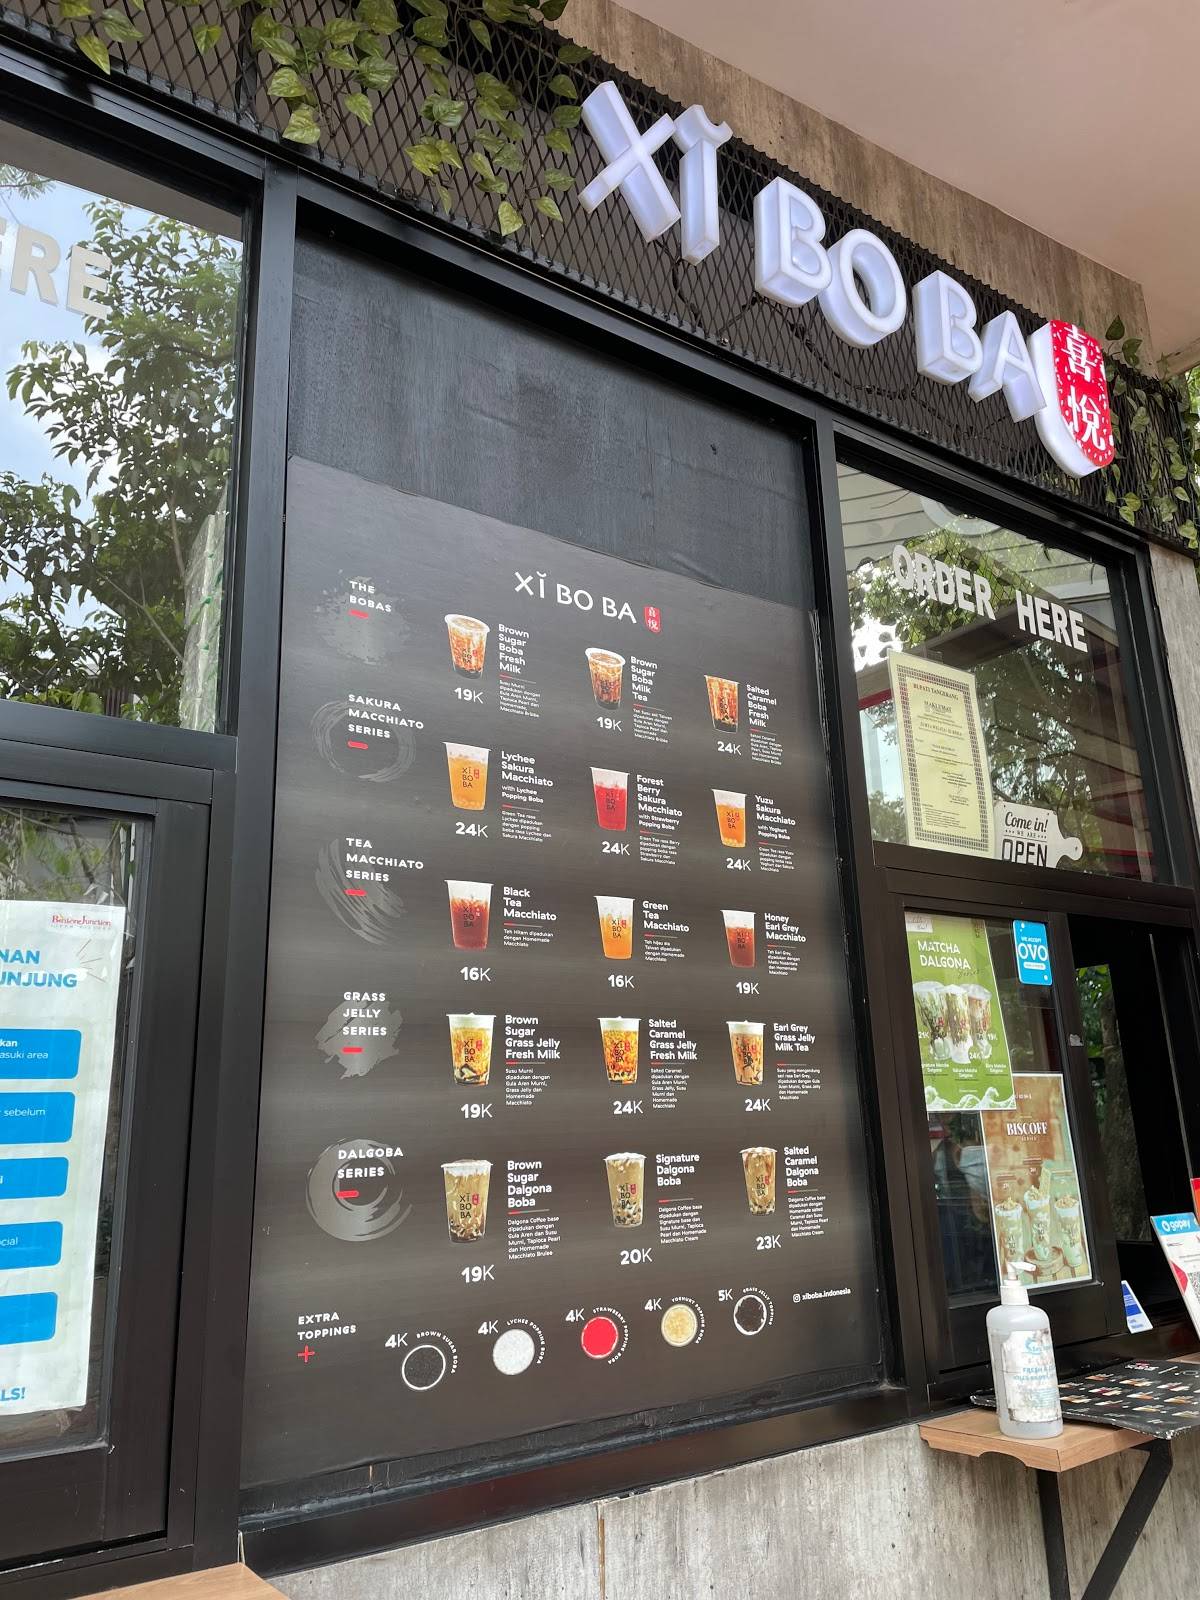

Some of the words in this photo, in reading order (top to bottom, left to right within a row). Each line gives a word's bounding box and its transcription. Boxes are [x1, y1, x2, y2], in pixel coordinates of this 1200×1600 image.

[754, 176, 906, 348] BO
[912, 270, 1047, 423] BA
[350, 581, 375, 594] THE
[350, 595, 392, 612] BOBAS
[557, 584, 593, 610] BO
[602, 597, 637, 623] BA
[892, 545, 996, 620] ORDER
[1016, 589, 1088, 653] HERE
[498, 624, 529, 638] Brown
[499, 634, 526, 647] Sugar
[499, 643, 523, 655] Boba
[500, 653, 525, 666] Fresh
[631, 656, 657, 669] Brown
[500, 662, 521, 673] Milk
[631, 666, 655, 677] Sugar
[632, 674, 653, 685] Boba
[632, 683, 651, 693] Milk
[747, 685, 769, 696] Salted
[455, 688, 484, 704] 19K
[632, 692, 648, 702] Tea
[747, 693, 776, 705] Caramel
[349, 694, 401, 711] SAKURA
[748, 701, 767, 711] Boba
[349, 708, 424, 729] MACCHIATO
[749, 710, 769, 720] Fresh
[597, 717, 622, 731] 19K
[749, 718, 766, 727] Milk
[348, 723, 390, 739] SERIES
[717, 741, 741, 755] 24K
[502, 751, 535, 764] Lychee
[502, 762, 534, 774] Sakura
[502, 771, 553, 786] Macchiato
[637, 775, 664, 786] Forest
[637, 784, 660, 796] Berry
[502, 792, 526, 802] Popping
[638, 794, 666, 804] Sakura
[755, 795, 773, 804] Yuzu
[638, 803, 682, 816] Macchiato
[756, 804, 781, 814] Sakura
[651, 816, 679, 825] Strawberry
[757, 813, 796, 825] Macchiato
[1005, 812, 1032, 829] Come
[1034, 818, 1048, 832] in!
[456, 822, 488, 838] 24K
[346, 838, 372, 848] TEA
[602, 841, 630, 855] 24K
[1002, 839, 1047, 867] OPEN
[346, 853, 424, 869] MACCHIATO
[727, 858, 751, 871] 24K
[346, 870, 389, 882] SERIES
[504, 887, 530, 897] Black
[503, 898, 521, 907] Tea
[643, 901, 668, 910] Green
[504, 908, 556, 921] Macchiato
[643, 910, 659, 919] Tea
[764, 913, 789, 923] Honey
[644, 920, 689, 932] Macchiato
[782, 924, 799, 933] Grey
[766, 931, 806, 942] Macchiato
[918, 940, 960, 954] MATCHA
[1018, 943, 1048, 961] OVO
[920, 955, 971, 969] DALGONA
[460, 967, 491, 981] 16K
[608, 975, 634, 988] 16K
[736, 982, 759, 994] 19K
[344, 992, 385, 1001] GRASS
[343, 1008, 381, 1018] JELLY
[505, 1015, 538, 1024] Brown
[649, 1019, 676, 1028] Salted
[343, 1027, 386, 1036] SERIES
[505, 1026, 535, 1037] Sugar
[774, 1023, 788, 1031] Earl
[791, 1024, 808, 1033] Grey
[649, 1030, 685, 1039] Caramel
[798, 1034, 815, 1044] Jelly
[505, 1038, 533, 1047] Grass
[537, 1038, 560, 1049] Jelly
[650, 1040, 674, 1049] Grass
[677, 1041, 696, 1051] Jelly
[775, 1043, 793, 1051] Milk
[795, 1043, 809, 1051] Tea
[506, 1049, 534, 1058] Fresh
[538, 1050, 560, 1059] Milk
[650, 1051, 675, 1060] Fresh
[678, 1051, 697, 1060] Milk
[461, 1104, 492, 1118] 19K
[613, 1100, 643, 1114] 24K
[745, 1099, 771, 1111] 24K
[4, 1108, 45, 1117] sebelum
[1007, 1122, 1048, 1136] BISCOFF
[338, 1147, 403, 1159] DALGOBA
[784, 1146, 809, 1155] Salted
[508, 1160, 542, 1170] Brown
[656, 1153, 700, 1165] Signature
[785, 1156, 817, 1166] Caramel
[338, 1167, 384, 1178] SERIES
[657, 1165, 694, 1176] Dalgona
[786, 1167, 818, 1178] Dalgona
[507, 1172, 538, 1184] Sugar
[658, 1177, 681, 1186] Boba
[787, 1178, 807, 1186] Boba
[508, 1185, 552, 1196] Dalgona
[508, 1198, 535, 1208] Boba
[1170, 1218, 1190, 1232] gopay
[756, 1235, 781, 1250] 23K
[620, 1248, 652, 1265] 20K
[462, 1265, 494, 1283] 19K
[718, 1289, 733, 1301] 5K
[802, 1288, 850, 1300] xiboba.indonesia
[645, 1298, 662, 1311] 4K
[298, 1312, 339, 1325] EXTRA
[566, 1308, 584, 1322] 4K
[593, 1307, 625, 1323] STRAWBERRY
[298, 1325, 356, 1341] TOPPINGS
[478, 1320, 498, 1334] 4K
[530, 1322, 545, 1344] POPPING
[385, 1333, 408, 1348] 4K
[443, 1335, 456, 1353] SUGAR
[537, 1347, 545, 1364] BOBA
[608, 1353, 621, 1364] BOBA
